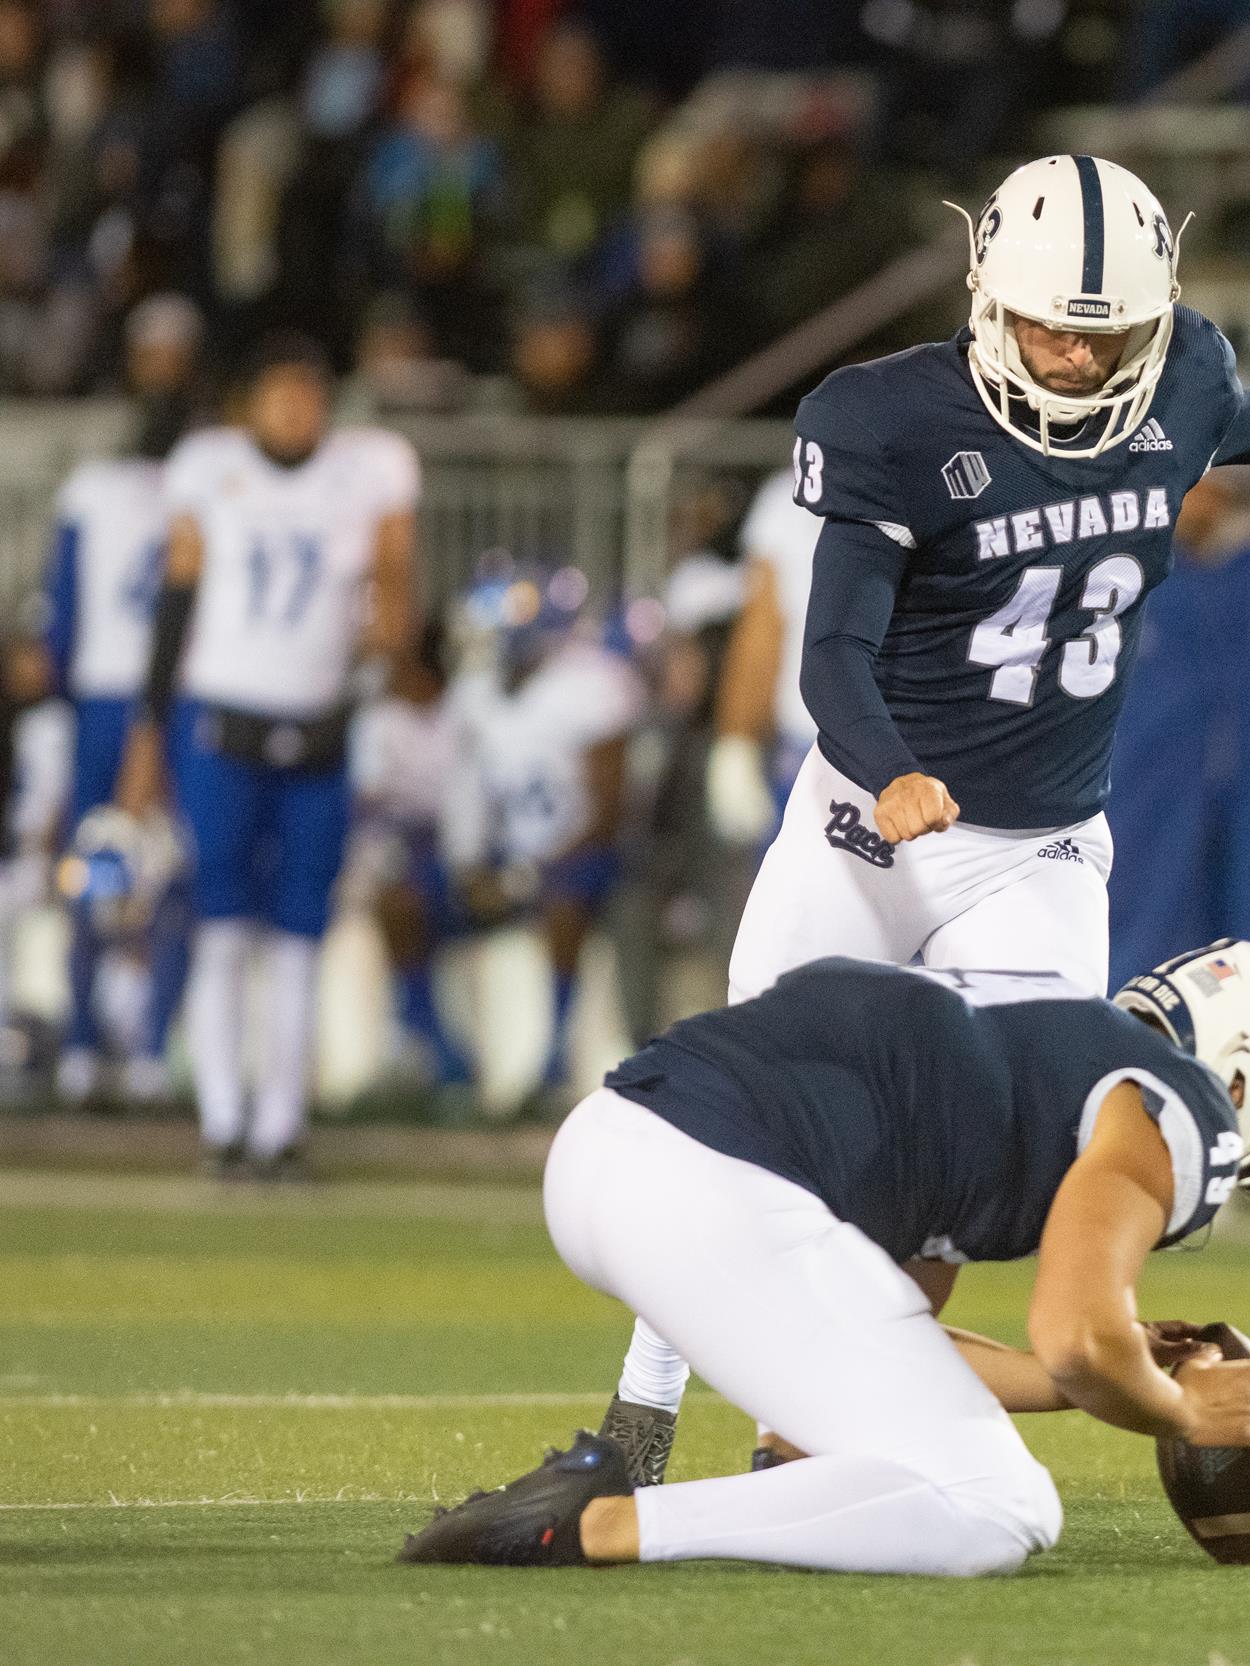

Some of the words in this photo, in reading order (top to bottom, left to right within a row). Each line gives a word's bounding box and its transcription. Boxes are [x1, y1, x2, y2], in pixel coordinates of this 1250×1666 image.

[1068, 302, 1109, 315] NEVADA
[1129, 439, 1173, 452] adidas
[974, 486, 1171, 562] NEVADA
[966, 552, 1145, 707] 43
[1152, 984, 1181, 1012] DIE
